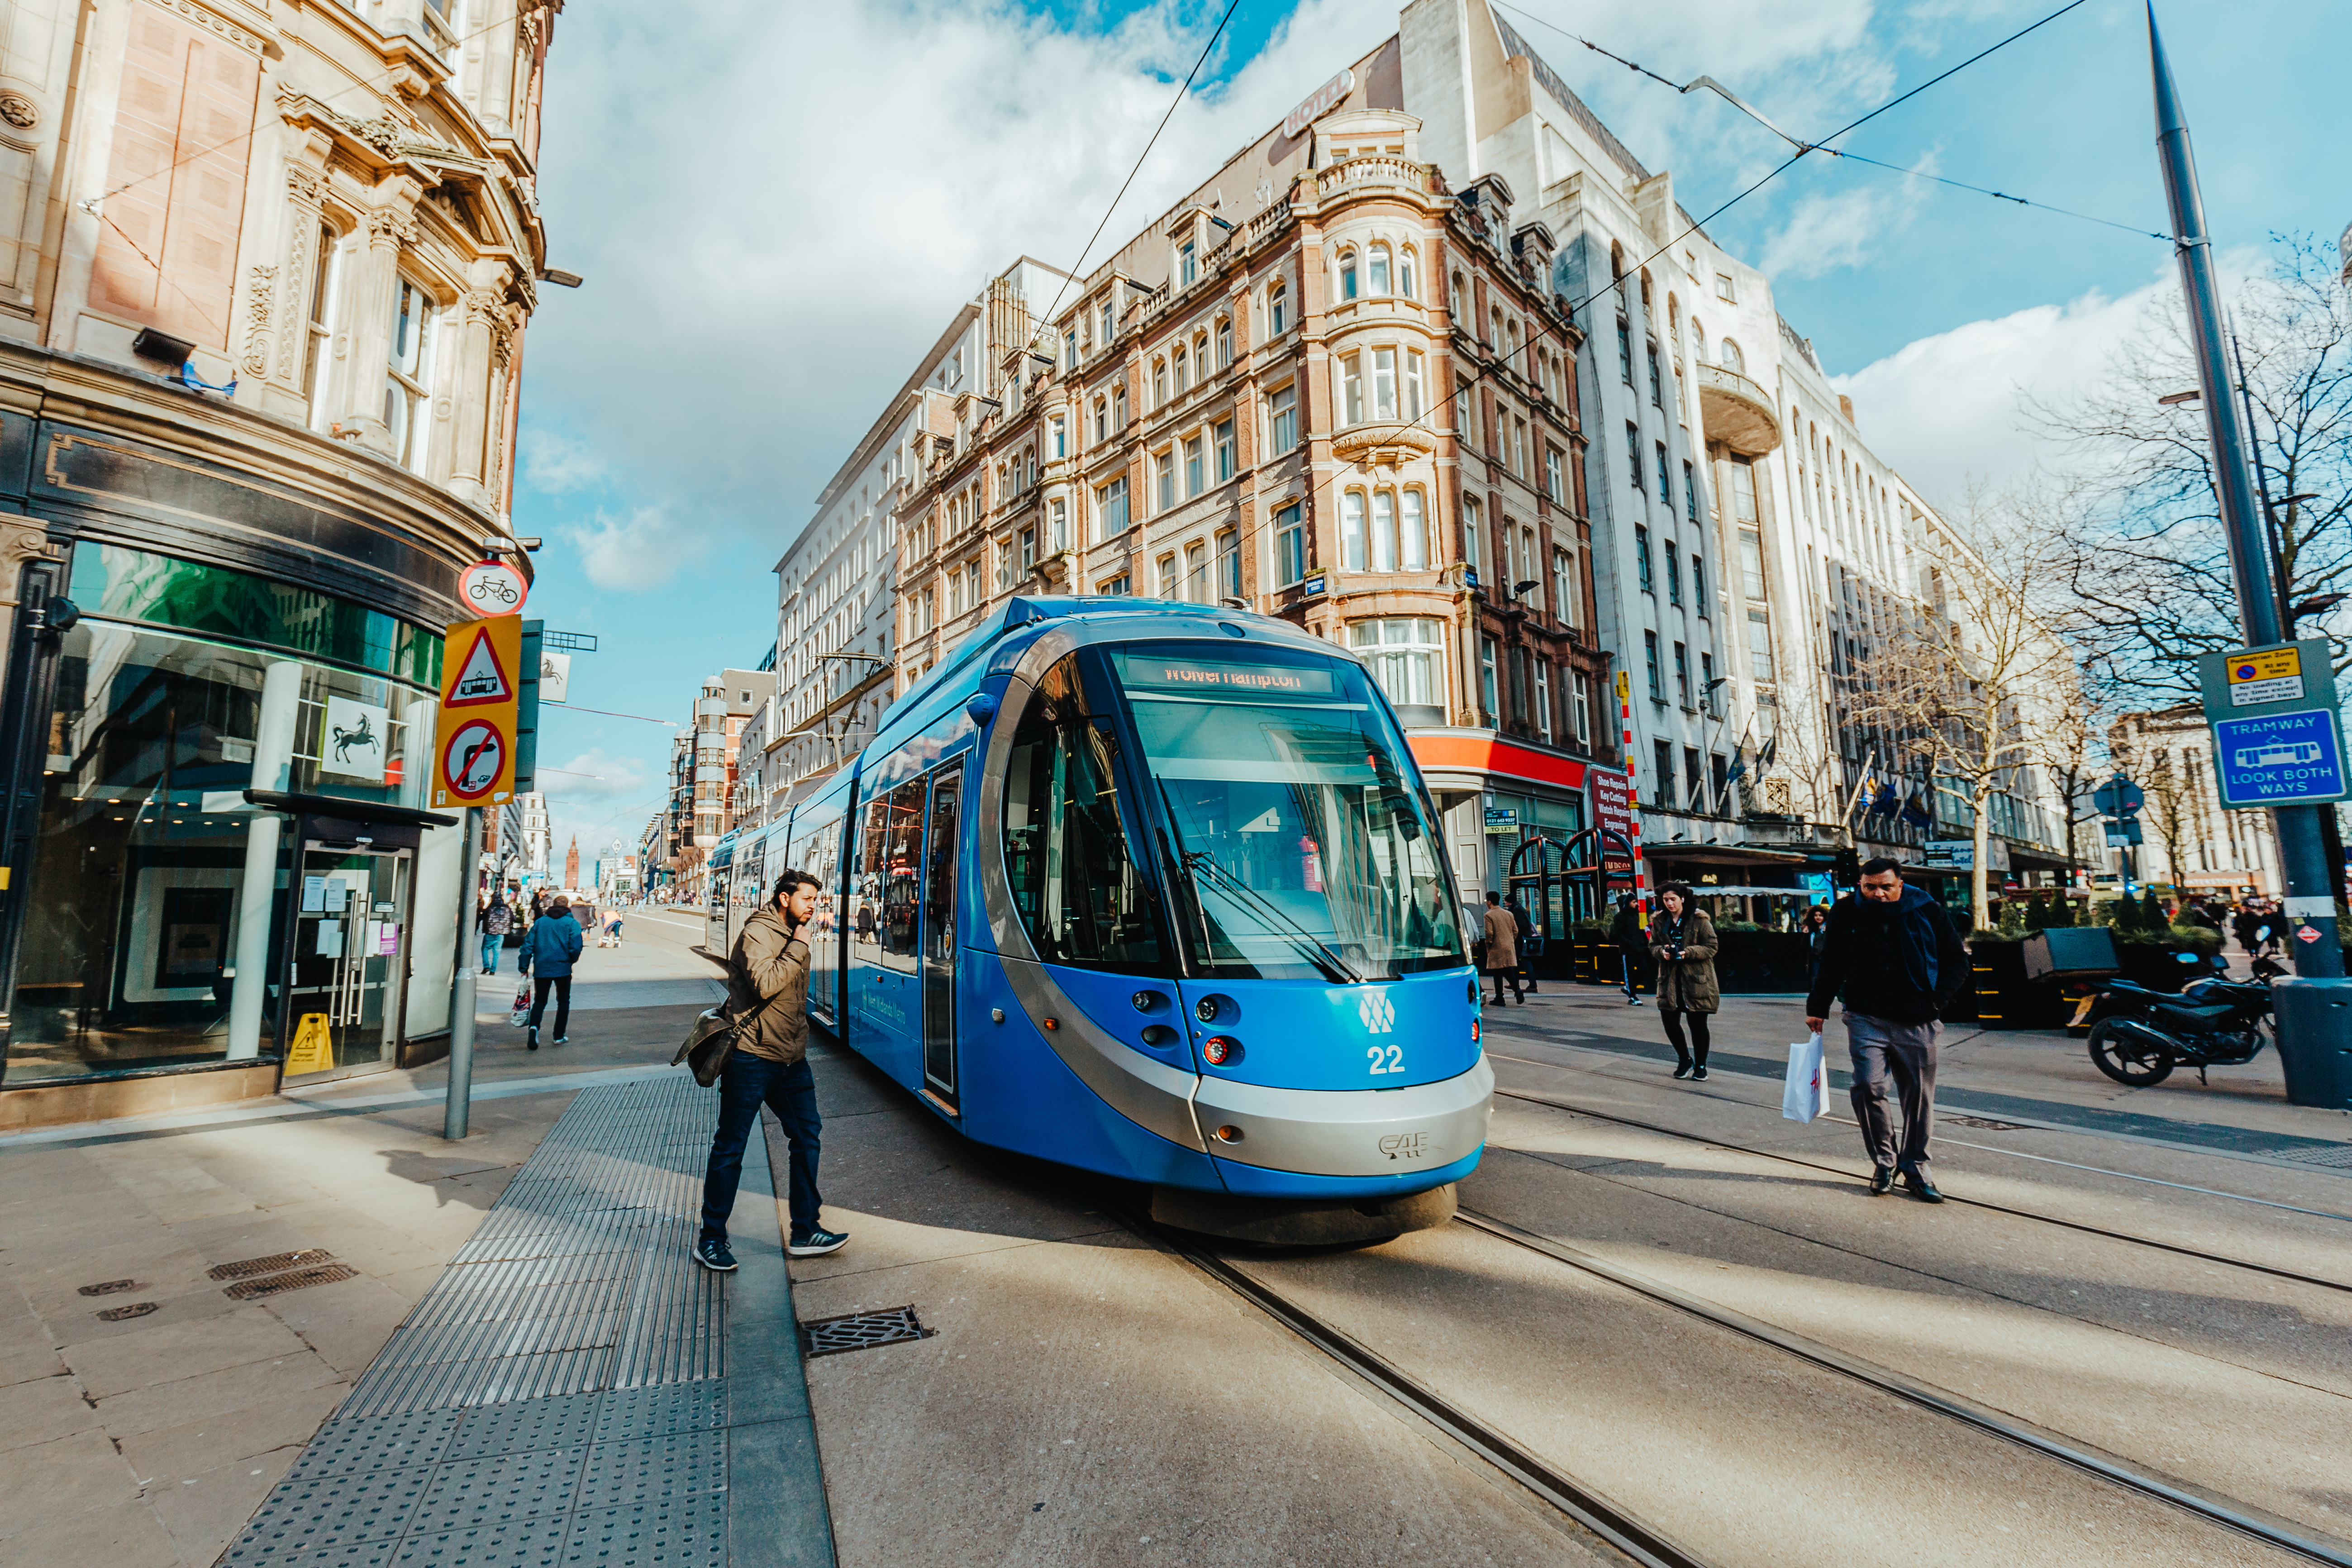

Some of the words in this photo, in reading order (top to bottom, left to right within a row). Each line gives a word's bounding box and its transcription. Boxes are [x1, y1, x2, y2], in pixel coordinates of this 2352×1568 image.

[1287, 75, 1348, 133] HOTEL
[2230, 655, 2271, 663] Pedestrian
[2230, 717, 2315, 735] TRAMWAY
[1597, 775, 1609, 786] Shoe
[1609, 777, 1627, 791] Repairs
[2231, 771, 2277, 784] LOOK
[2283, 767, 2333, 780] BOTH
[2258, 782, 2308, 794] WAYS
[1600, 790, 1609, 802] Key
[1609, 791, 1627, 805] Cutting
[1598, 803, 1614, 815] Watch
[1614, 805, 1630, 818] Repairs
[1604, 818, 1627, 832] Engraving
[1605, 861, 1631, 869] IMPSO
[1952, 853, 1972, 865] otel
[1367, 1045, 1405, 1074] 22
